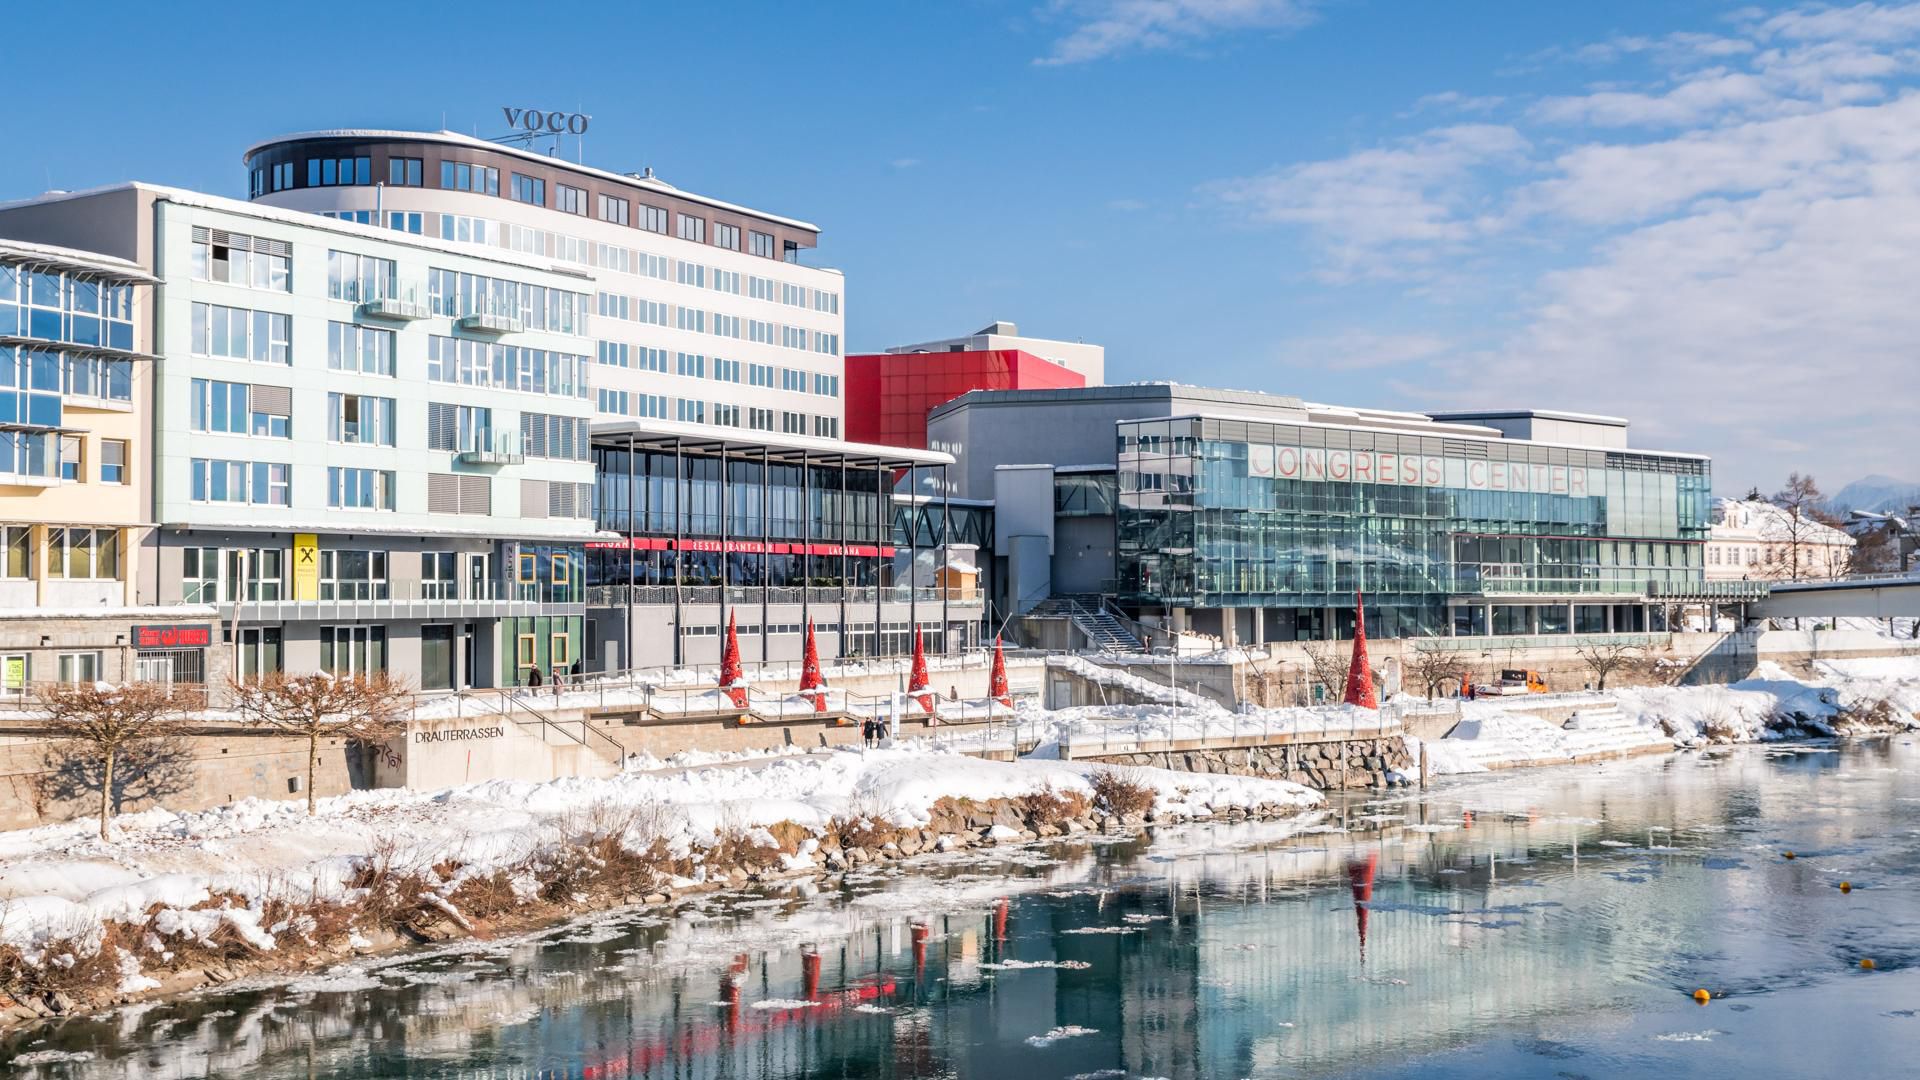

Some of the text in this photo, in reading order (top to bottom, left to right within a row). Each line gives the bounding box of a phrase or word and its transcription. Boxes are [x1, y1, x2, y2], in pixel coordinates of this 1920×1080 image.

[1252, 447, 1585, 492] CONGRESS CENTER
[415, 727, 504, 743] DRAUTERRASSEN
